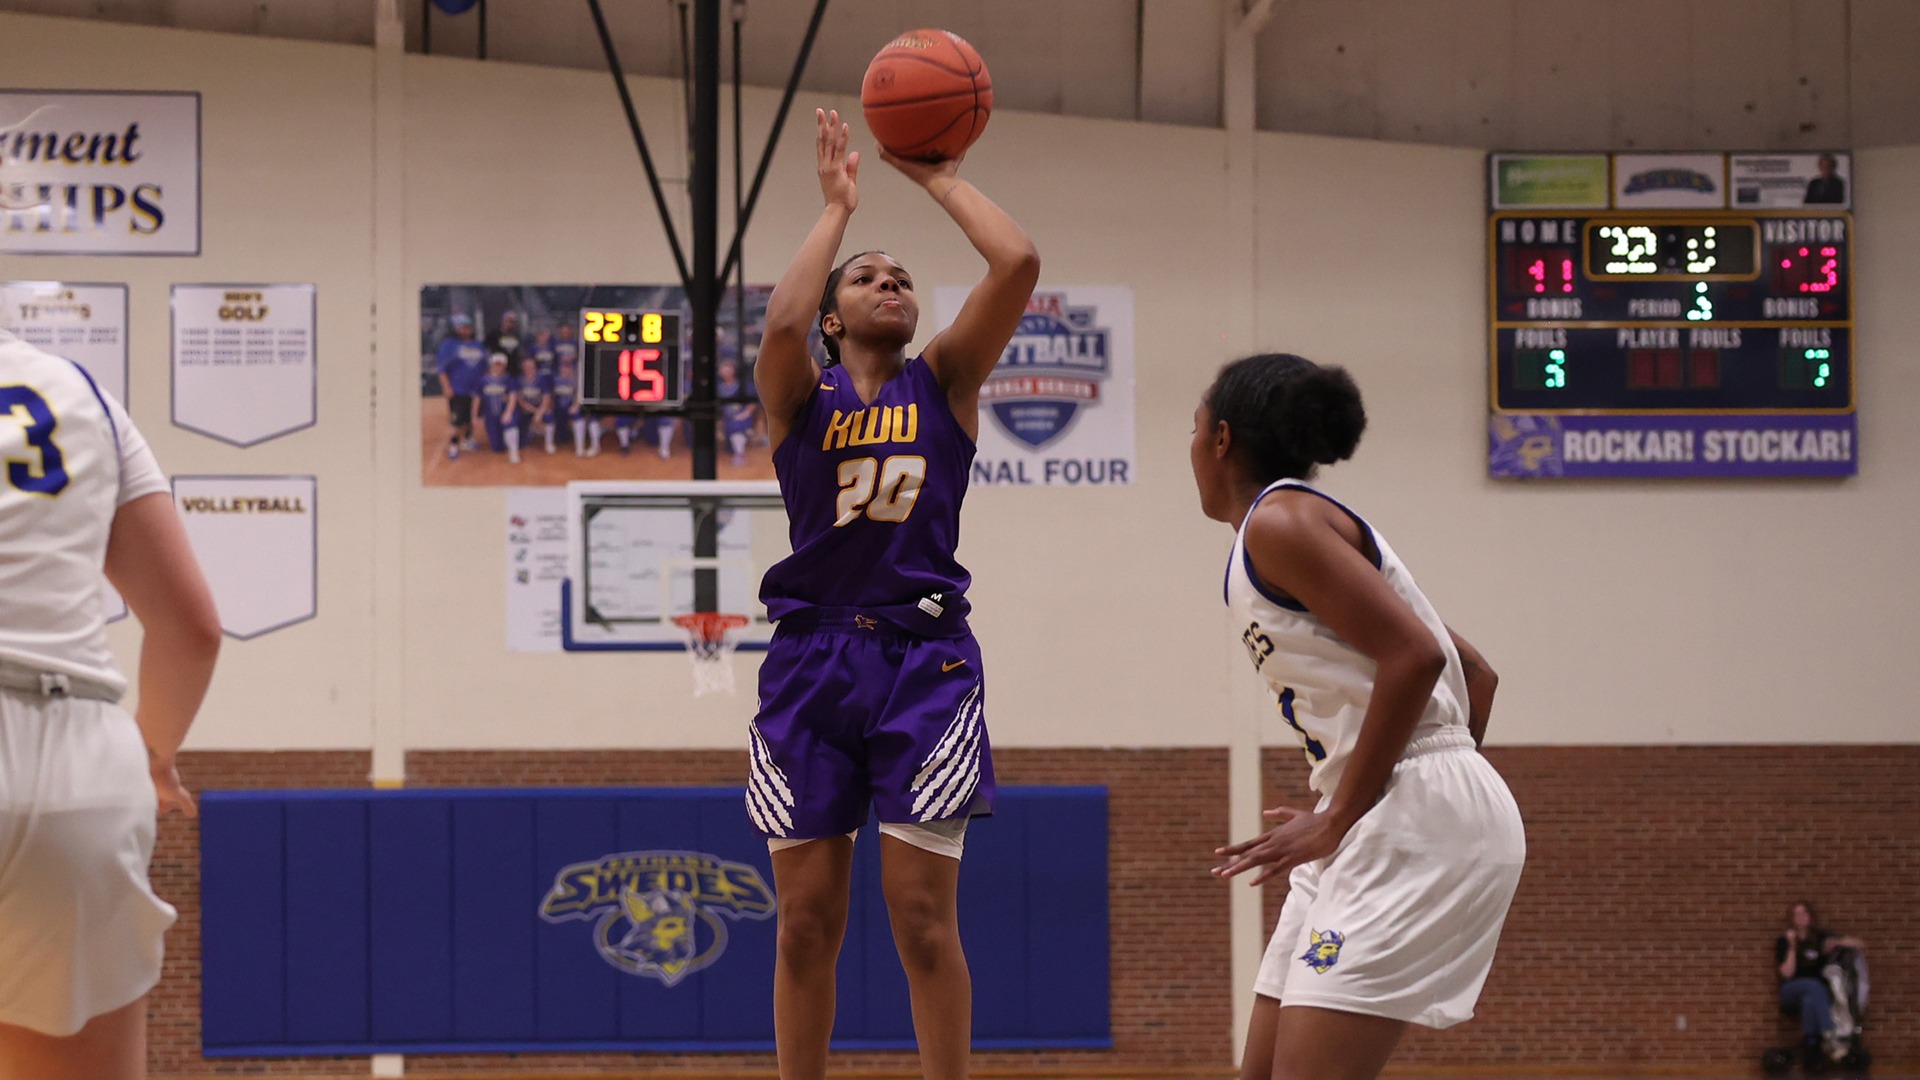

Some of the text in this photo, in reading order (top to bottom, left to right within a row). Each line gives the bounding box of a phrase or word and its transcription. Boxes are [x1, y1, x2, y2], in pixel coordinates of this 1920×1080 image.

[0, 121, 143, 166] ment
[1502, 220, 1577, 243] HOME
[1763, 220, 1845, 243] VISITOR
[218, 305, 269, 322] GOLF
[1527, 298, 1583, 318] BONUS
[1628, 299, 1681, 318] PERIOD
[1763, 298, 1819, 318] BONUS
[1515, 328, 1567, 349] FOULS
[1617, 328, 1742, 349] PLAYER FOULS
[1779, 327, 1832, 348] FOULS
[618, 349, 665, 401] 15
[822, 403, 918, 451] KWU
[1563, 430, 1851, 462] ROCKAR! STOCKAR!
[972, 459, 1129, 484] NAL FOUR
[833, 455, 927, 527] 20
[182, 496, 307, 514] VOLLEYBALL
[543, 864, 775, 914] SWEDES
